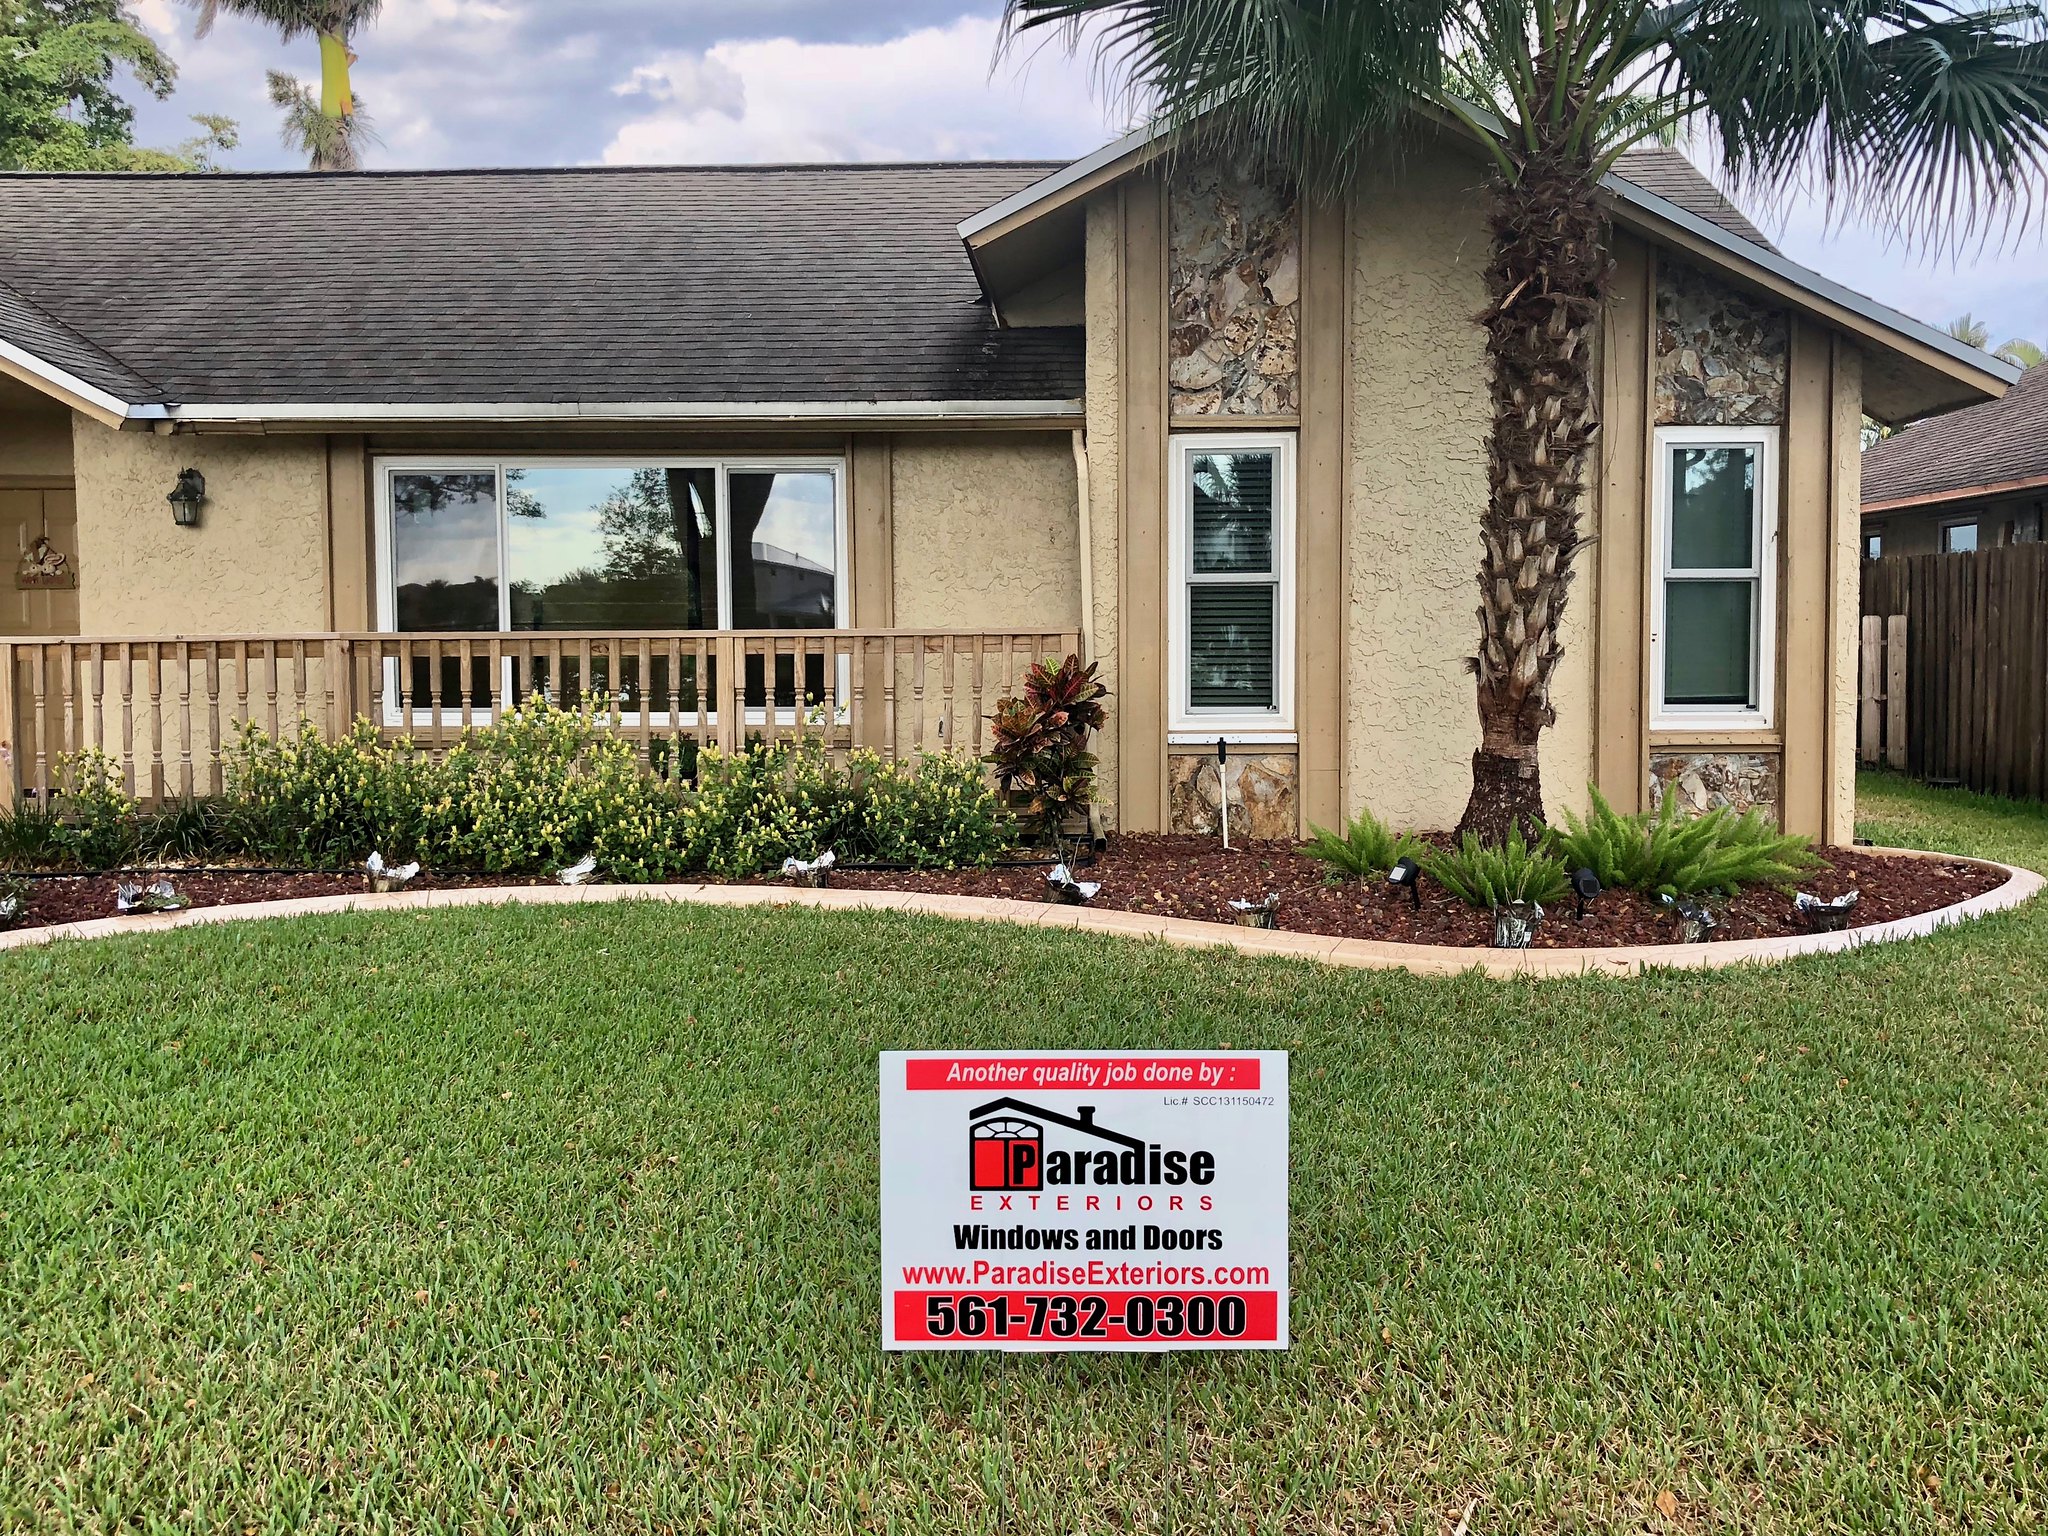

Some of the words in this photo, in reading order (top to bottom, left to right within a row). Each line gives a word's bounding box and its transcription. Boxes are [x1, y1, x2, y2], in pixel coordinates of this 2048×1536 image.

[946, 1062, 1028, 1082] Another
[1032, 1062, 1100, 1087] quality
[1103, 1062, 1137, 1087] job
[1143, 1062, 1193, 1082] done
[1199, 1062, 1224, 1087] by
[1163, 1096, 1188, 1106] Lic.#
[1193, 1096, 1275, 1106] SCC131150472
[1012, 1142, 1216, 1186] Paradise
[970, 1195, 1213, 1211] EXTERIORS
[953, 1224, 1079, 1250] Windows
[1085, 1224, 1137, 1250] and
[1143, 1225, 1223, 1250] Doors
[902, 1260, 1270, 1286] www.ParadiseExteriors.com
[926, 1295, 1247, 1338] 561-732-0300
